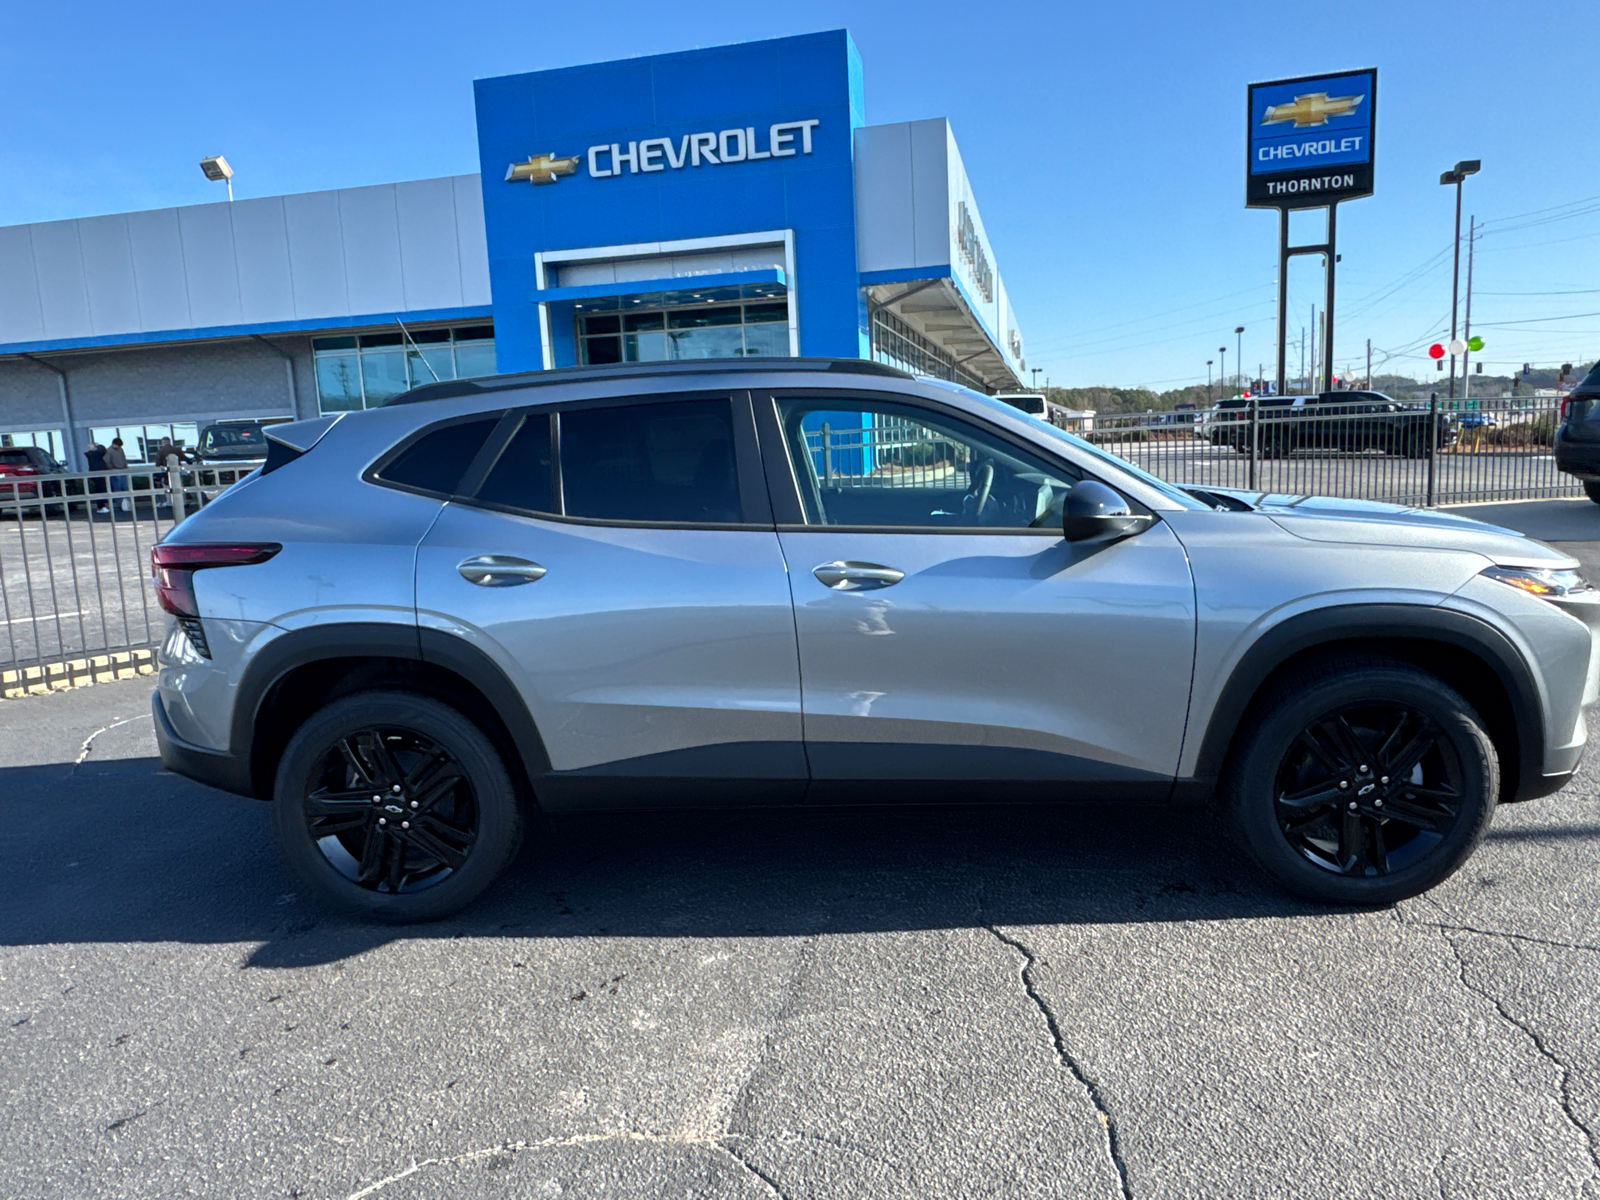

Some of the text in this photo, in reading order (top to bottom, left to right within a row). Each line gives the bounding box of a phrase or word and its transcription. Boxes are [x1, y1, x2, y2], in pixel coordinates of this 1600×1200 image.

[587, 119, 820, 178] CHEVROLET
[1258, 136, 1363, 161] CHEVROLET
[1266, 174, 1354, 195] THORNTON
